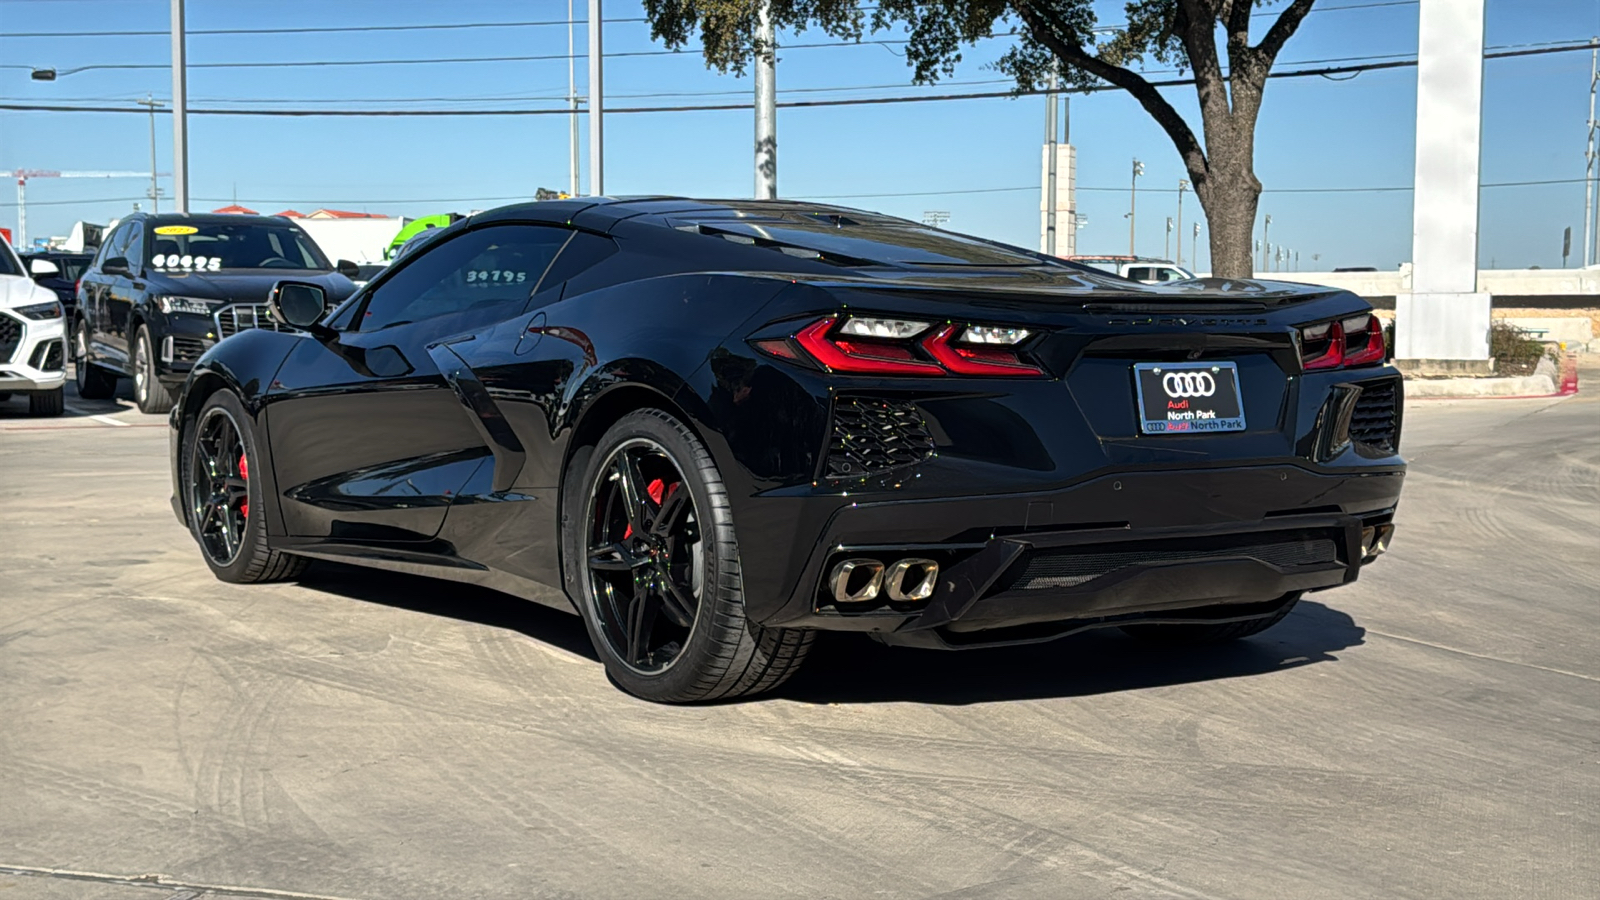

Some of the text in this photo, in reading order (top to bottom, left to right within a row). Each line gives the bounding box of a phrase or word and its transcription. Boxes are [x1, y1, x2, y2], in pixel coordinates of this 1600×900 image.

[152, 254, 221, 271] 40495
[467, 270, 526, 282] 34795
[1167, 400, 1189, 409] Audi
[1167, 410, 1216, 420] North Park
[1191, 420, 1219, 430] North
[1221, 420, 1242, 429] Park
